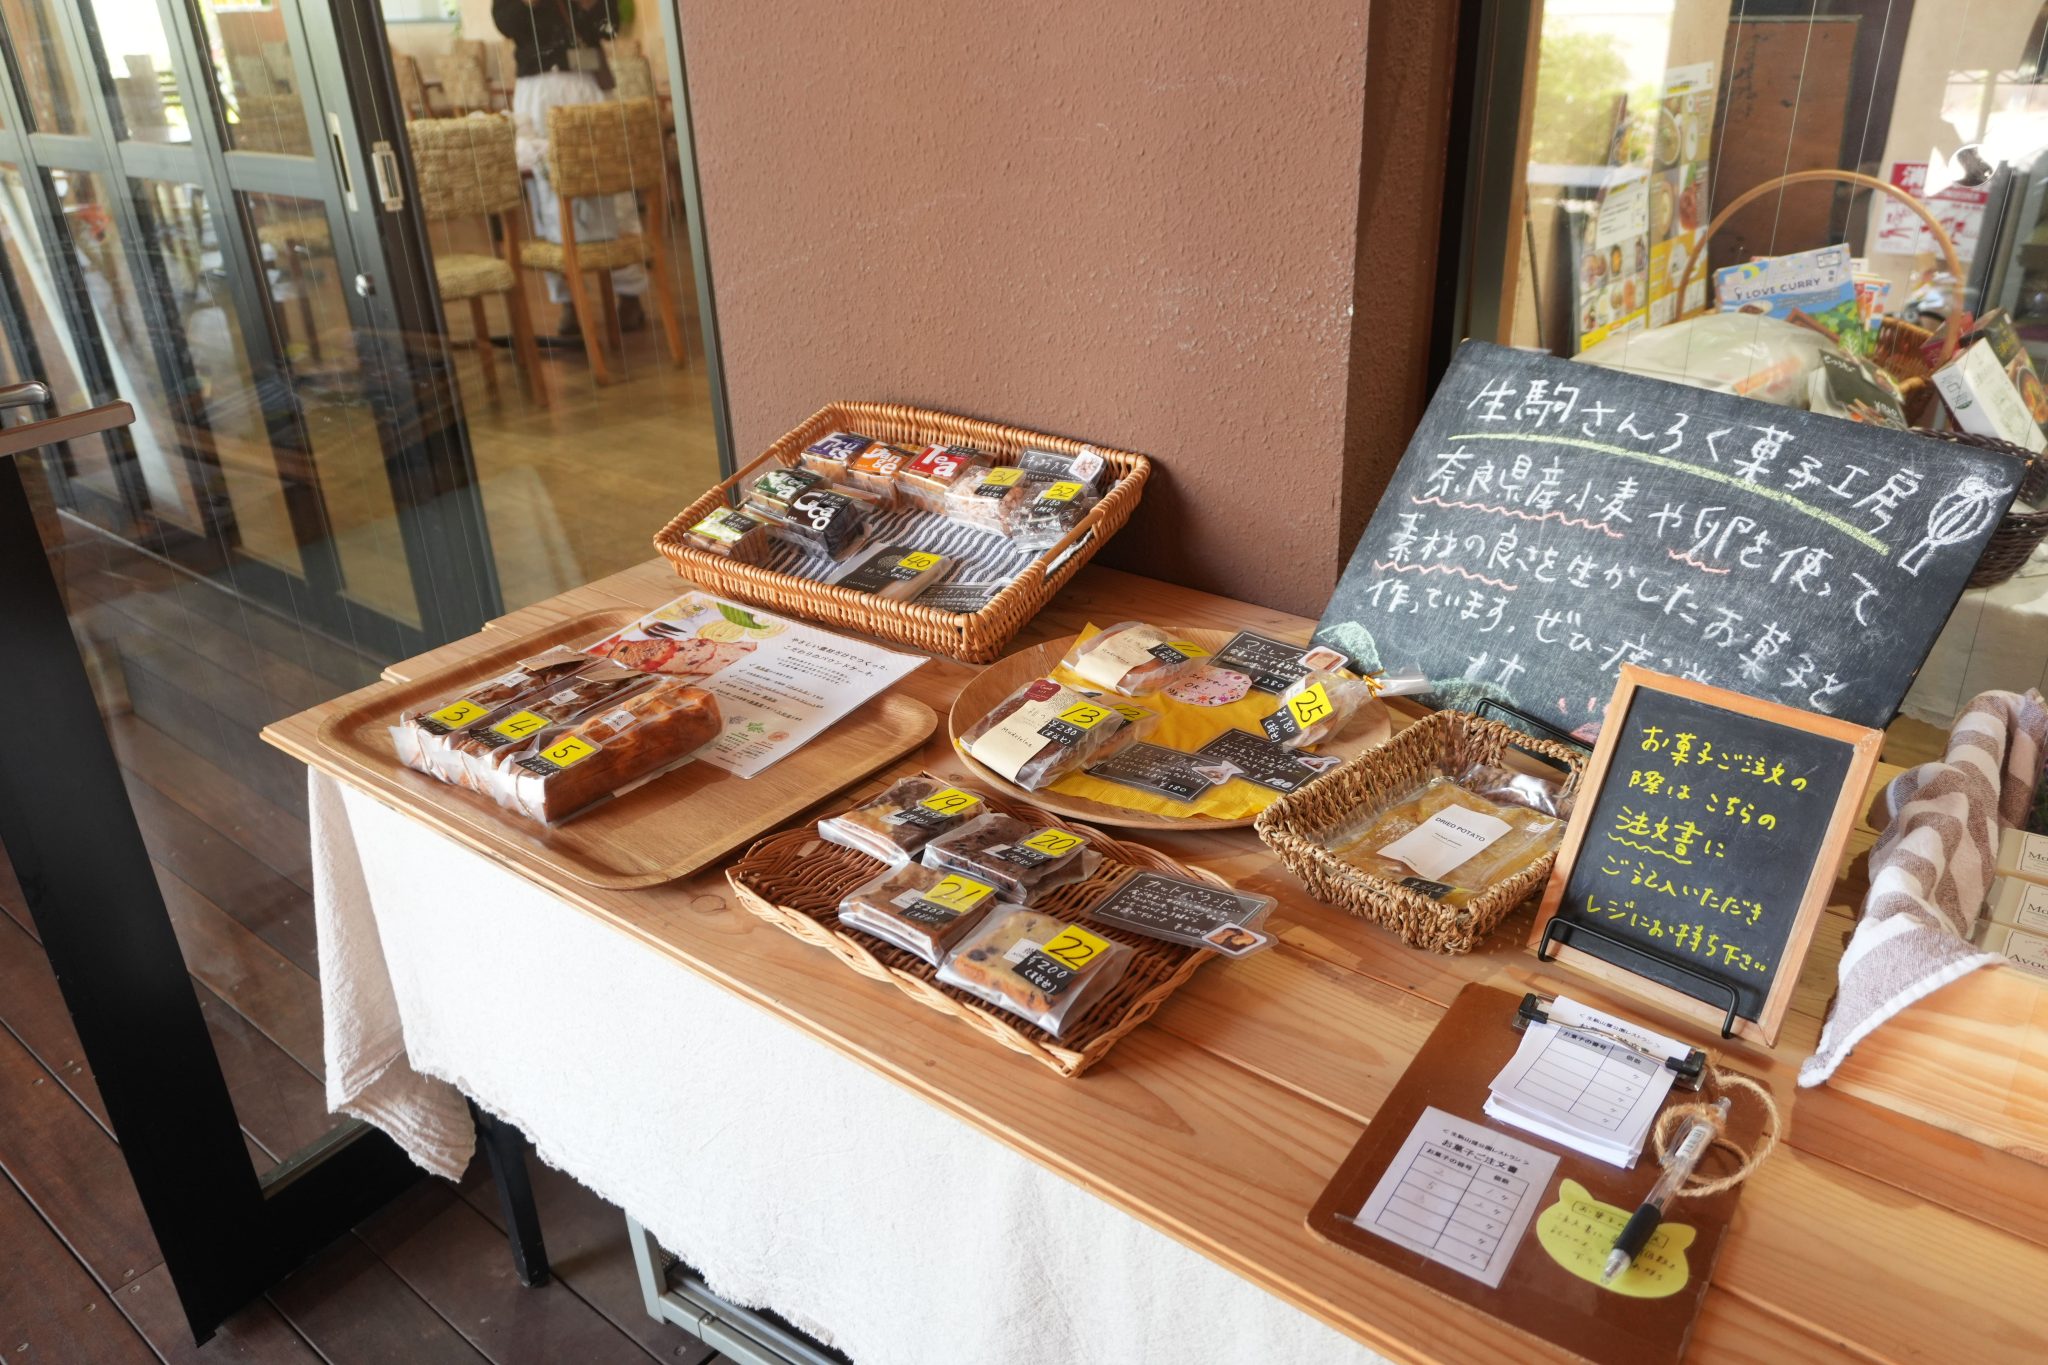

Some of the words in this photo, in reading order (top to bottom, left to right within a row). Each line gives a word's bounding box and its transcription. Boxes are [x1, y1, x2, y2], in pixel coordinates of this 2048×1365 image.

[1746, 286, 1776, 300] LOVE
[1780, 278, 1821, 293] CURRY
[921, 444, 958, 476] Tea
[1467, 377, 1925, 535] 生駒さんろく菓子工房
[992, 470, 1016, 482] 31
[1052, 485, 1075, 498] 32
[1424, 445, 1880, 627] 奈良県産小麦や卵を使って
[907, 555, 931, 568] 40
[1387, 511, 1849, 713] 素材の良さを生かしたお菓子を
[443, 707, 470, 723] 3
[1061, 706, 1100, 723] 13
[1296, 690, 1324, 723] 25
[509, 719, 533, 734] 4
[1048, 720, 1077, 736] ¥280
[553, 744, 580, 759] 5
[1641, 726, 1807, 790] お菓子ご注文の
[928, 794, 967, 811] 19
[1435, 817, 1457, 829] DRIED
[1456, 826, 1486, 842] POTATO
[1615, 806, 1725, 858] 注文書に
[1031, 834, 1077, 851] 20
[931, 882, 981, 903] 21
[1601, 856, 1763, 926] ご記入いただき
[1048, 935, 1094, 968] 22
[1027, 954, 1068, 978] ¥200
[1563, 1031, 1607, 1050] お菓子の番号
[1426, 1148, 1473, 1171] お菓子の番号
[1441, 1139, 1519, 1174] お菓子ご注文書
